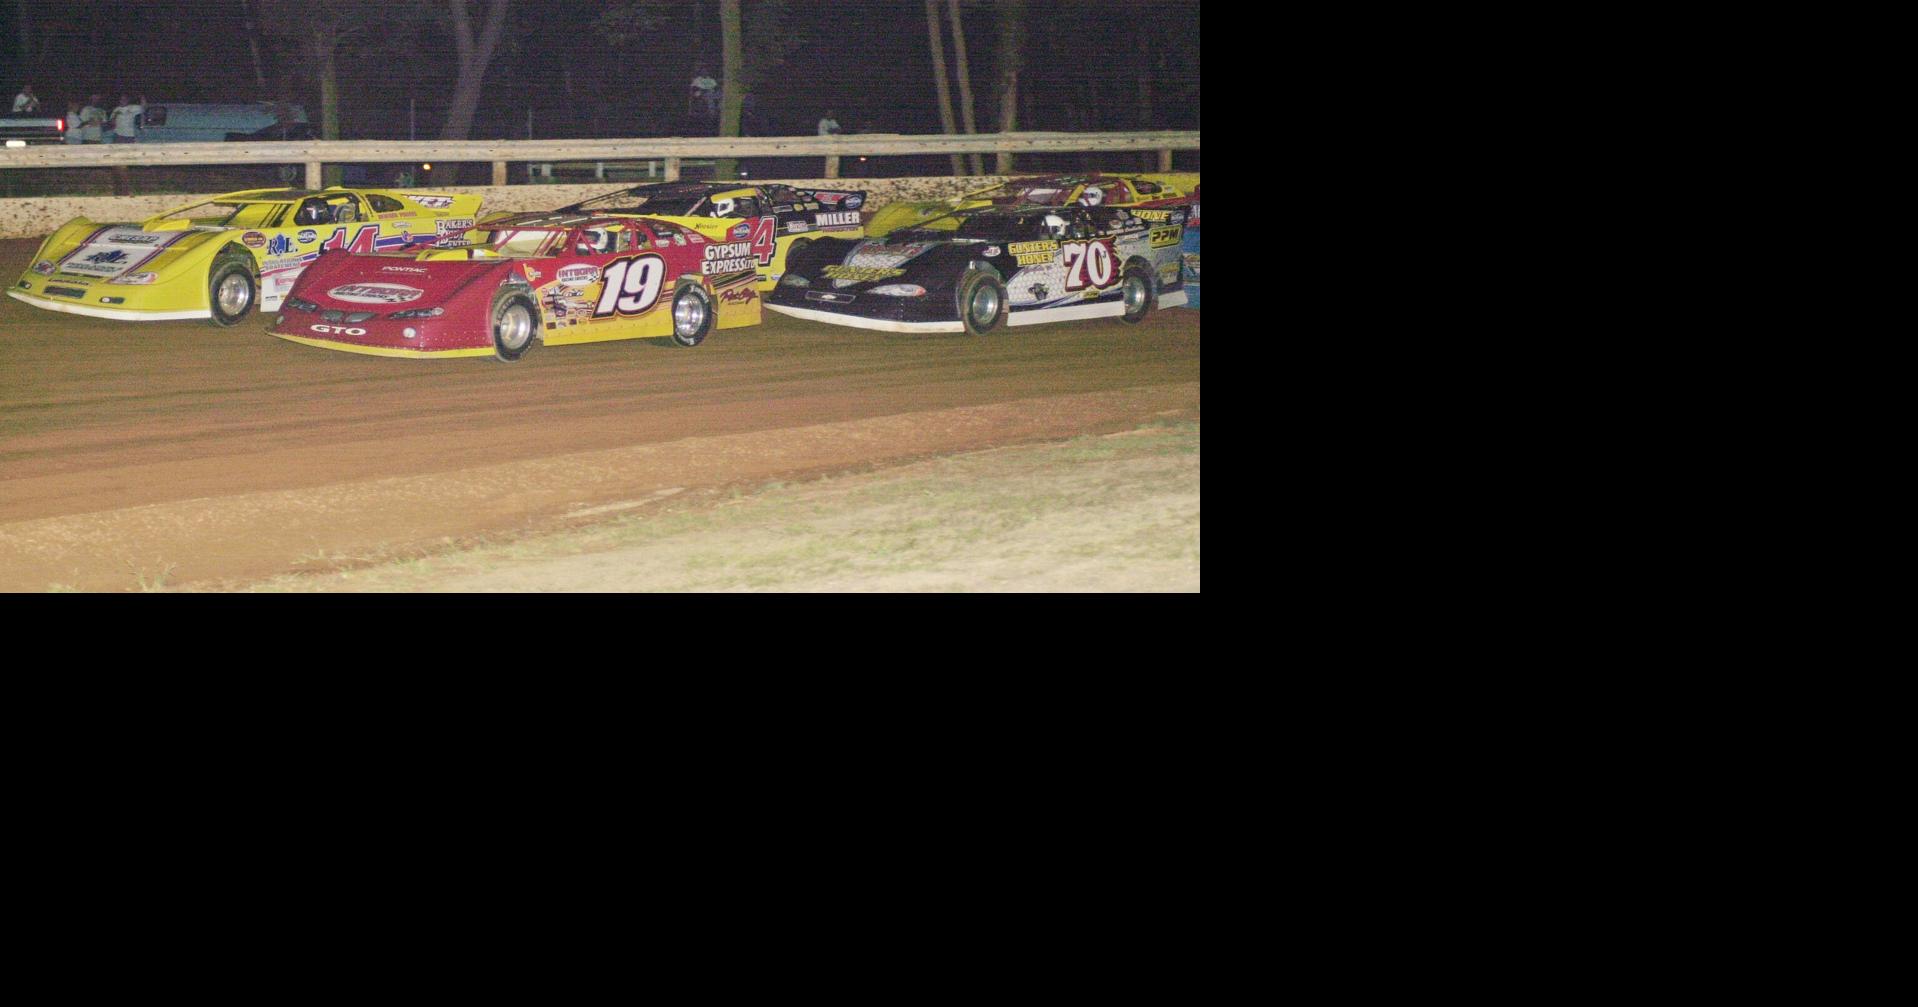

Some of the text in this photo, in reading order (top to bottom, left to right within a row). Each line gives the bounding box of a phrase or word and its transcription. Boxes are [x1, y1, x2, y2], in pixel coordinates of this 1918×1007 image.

[436, 219, 473, 235] BAKER'S
[816, 211, 860, 227] MILLER
[1151, 228, 1180, 243] PPM
[704, 242, 751, 260] GYPSUM
[702, 259, 745, 275] EXPRESS
[1017, 252, 1055, 267] HONEY
[1062, 240, 1114, 291] 70
[592, 253, 666, 318] 19
[310, 324, 367, 336] GTO
